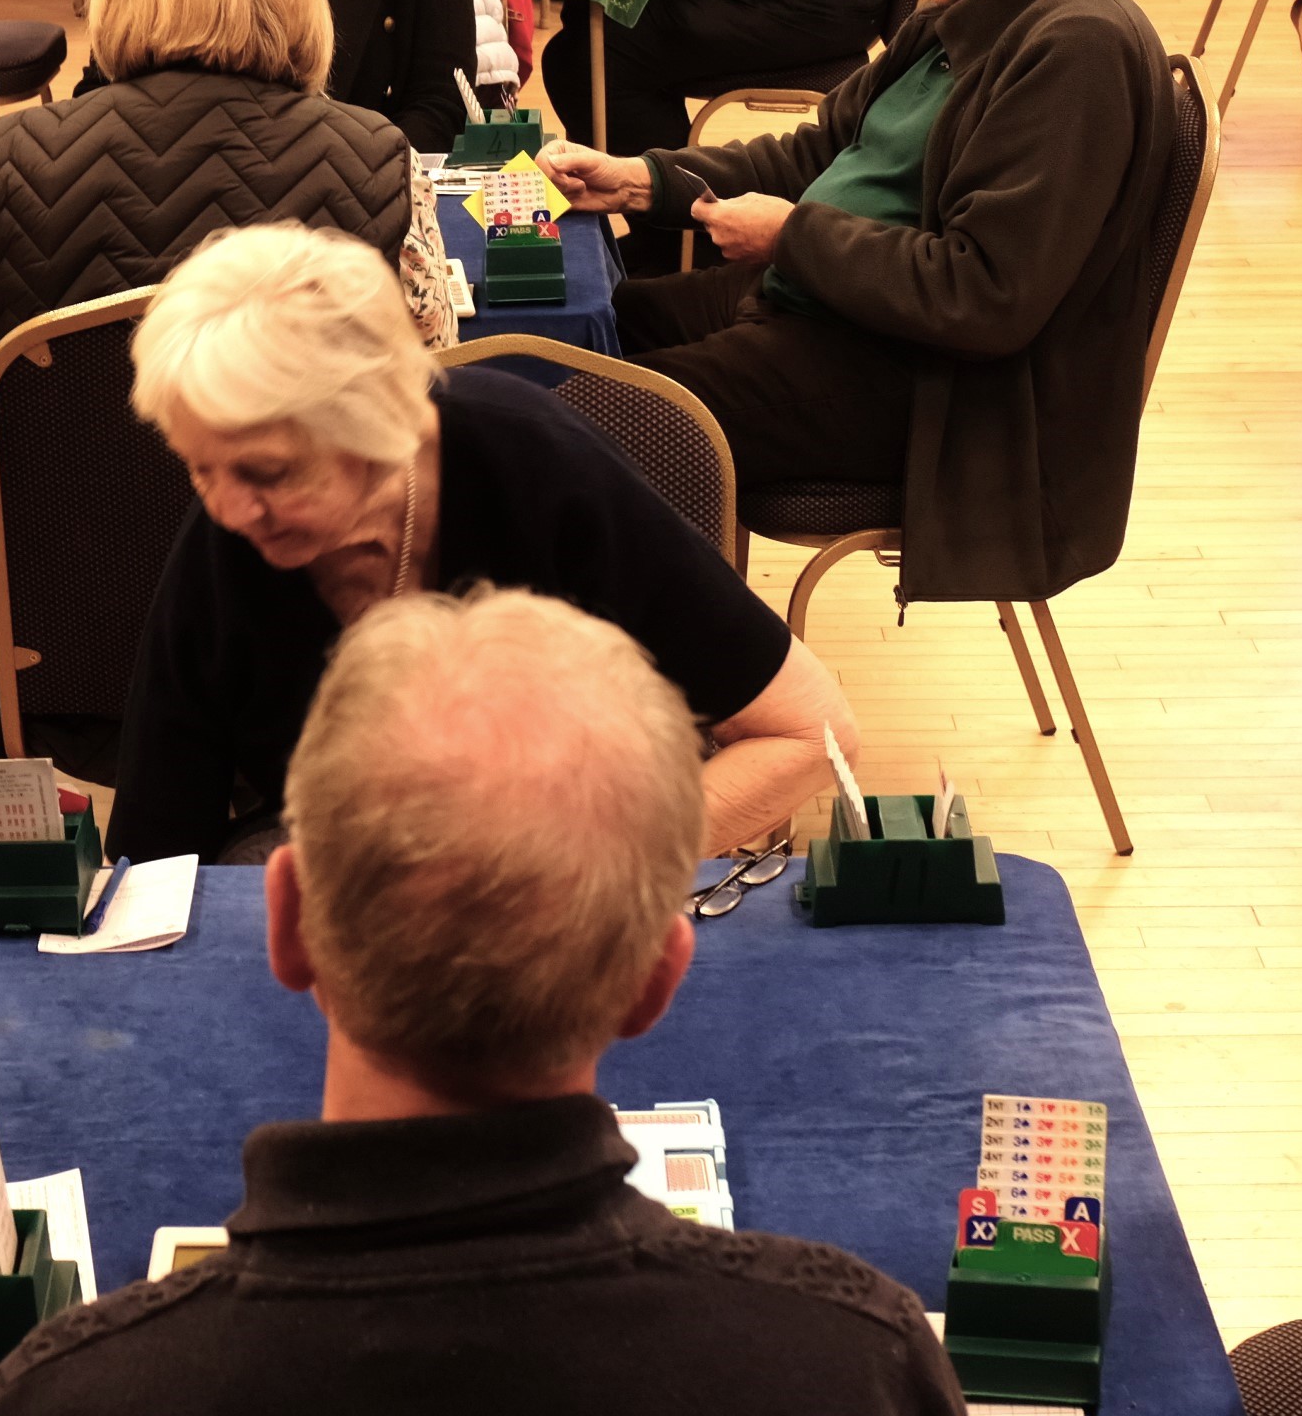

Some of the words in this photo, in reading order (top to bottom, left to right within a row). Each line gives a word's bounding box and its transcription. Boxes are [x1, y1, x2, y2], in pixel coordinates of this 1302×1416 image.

[500, 216, 507, 224] S
[537, 212, 546, 221] A
[539, 225, 549, 235] X
[985, 1116, 1004, 1127] 2NT
[985, 1135, 1003, 1146] 3NT
[984, 1152, 1003, 1161] 4NT
[979, 1169, 999, 1180] 5NT
[971, 1197, 987, 1216] S
[1073, 1201, 1090, 1221] A
[1013, 1227, 1055, 1243] PASS
[1062, 1226, 1081, 1252] X
